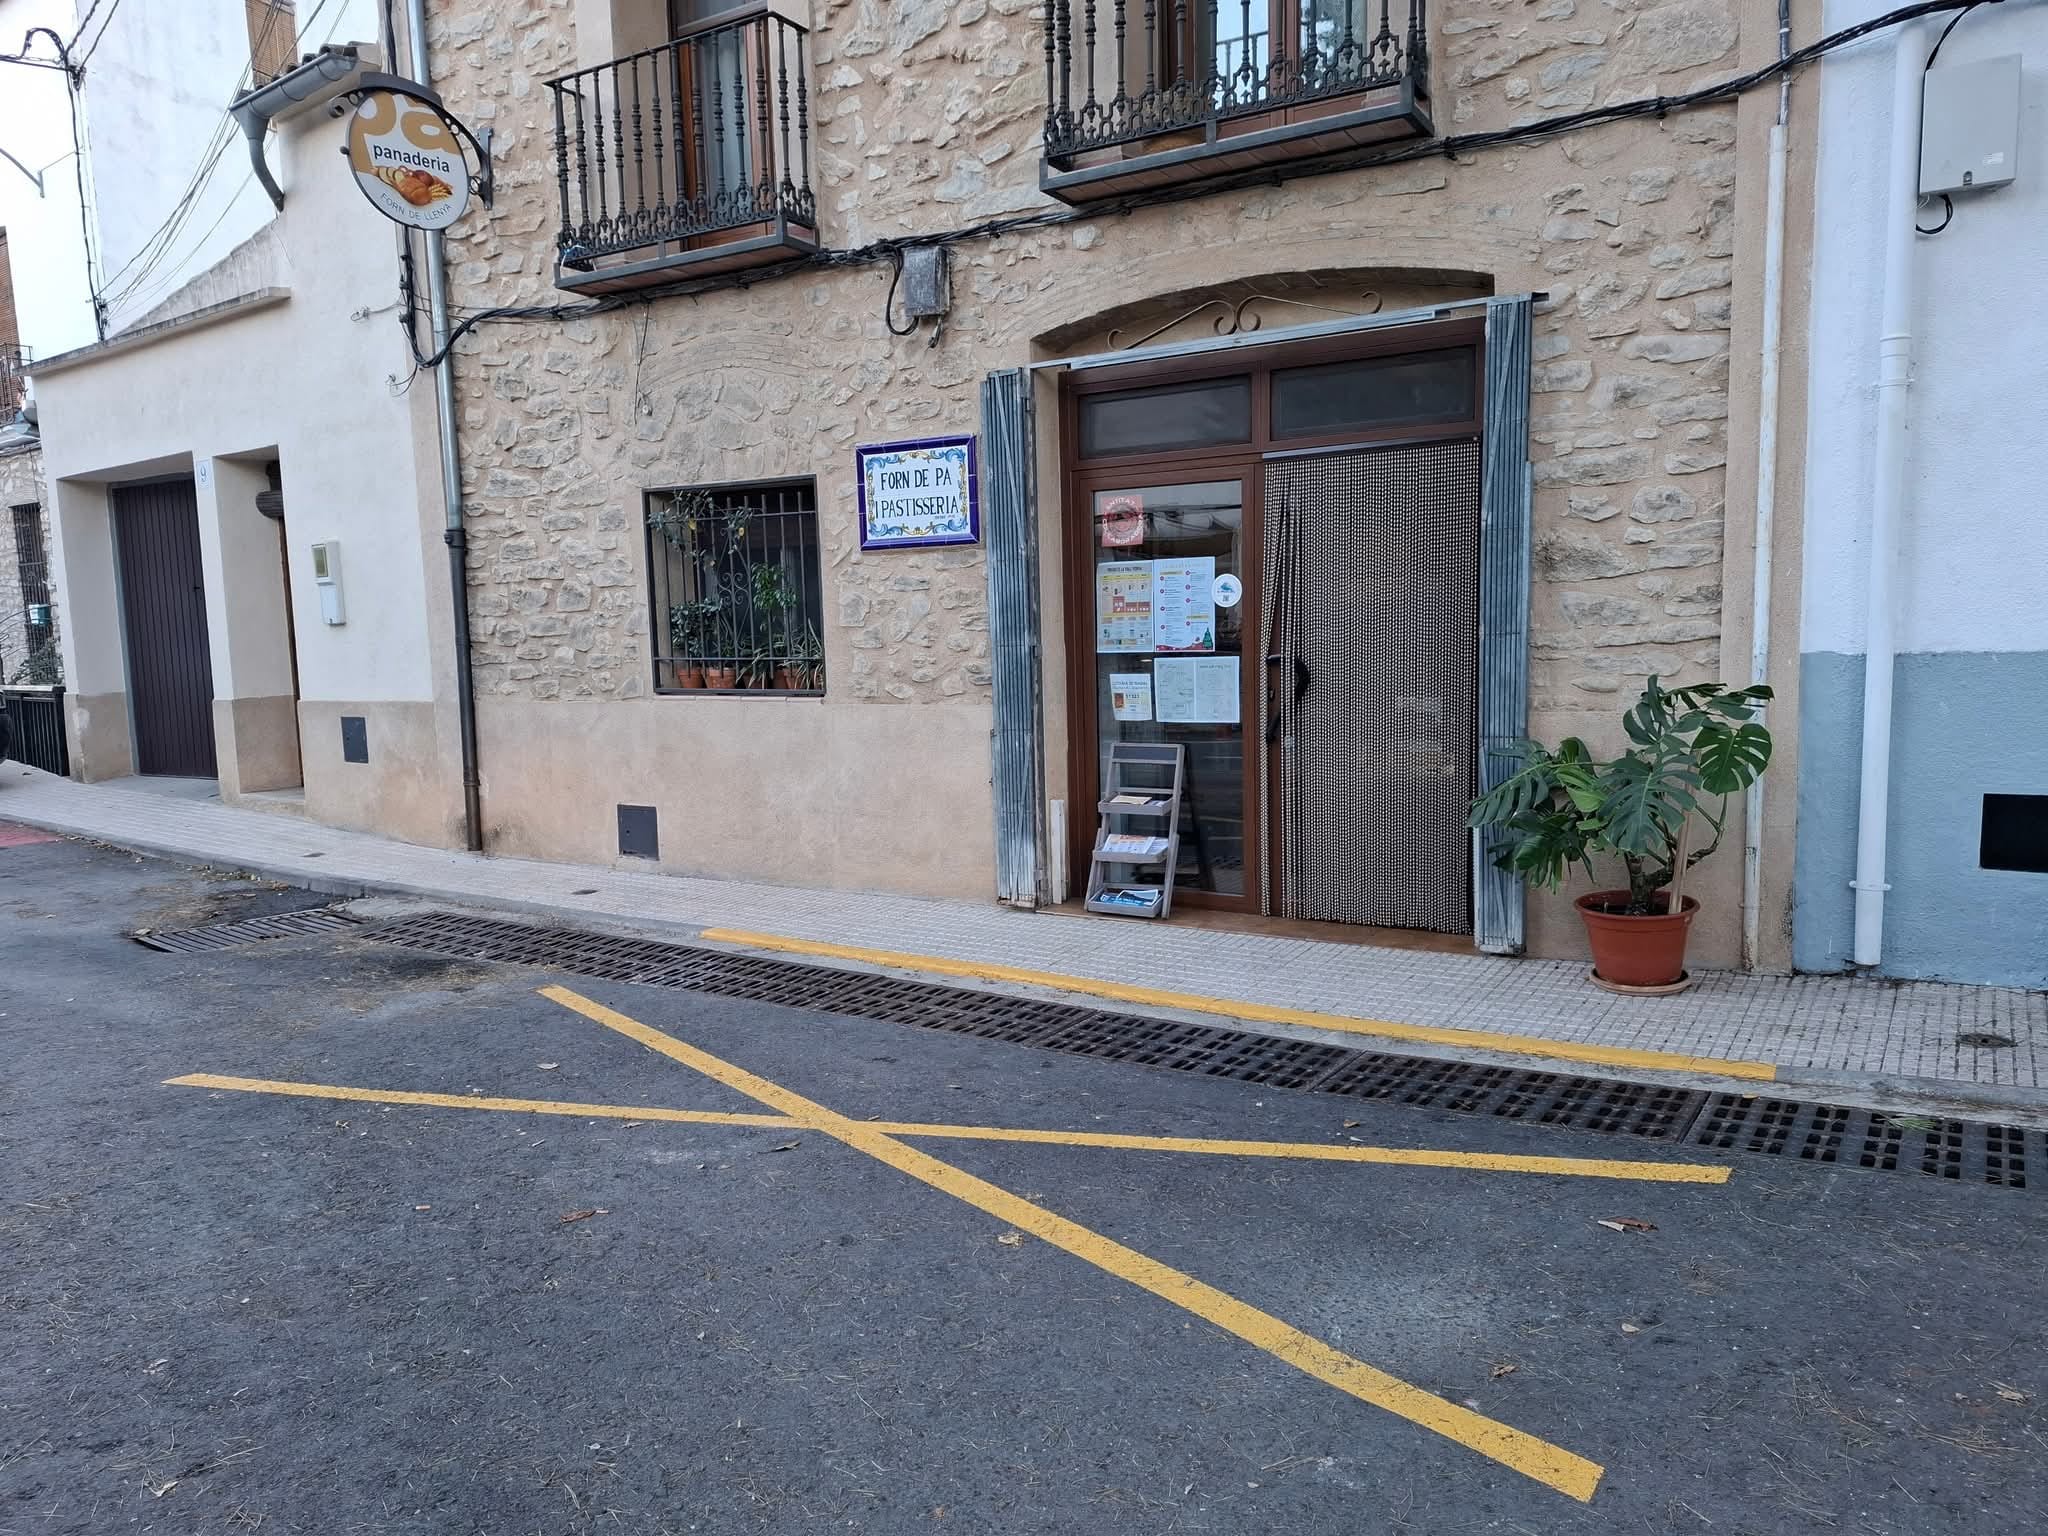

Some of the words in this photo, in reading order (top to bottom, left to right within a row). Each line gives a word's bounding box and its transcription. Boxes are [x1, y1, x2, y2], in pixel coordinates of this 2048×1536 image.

[373, 144, 450, 173] panaderia
[381, 192, 406, 215] FORN
[408, 208, 421, 220] DE
[425, 202, 452, 221] LLENYA
[200, 464, 207, 483] 9
[880, 470, 910, 491] FORN
[914, 468, 930, 488] DE
[935, 466, 952, 487] PA
[875, 500, 879, 519] I
[881, 495, 959, 519] PASTISSERIA
